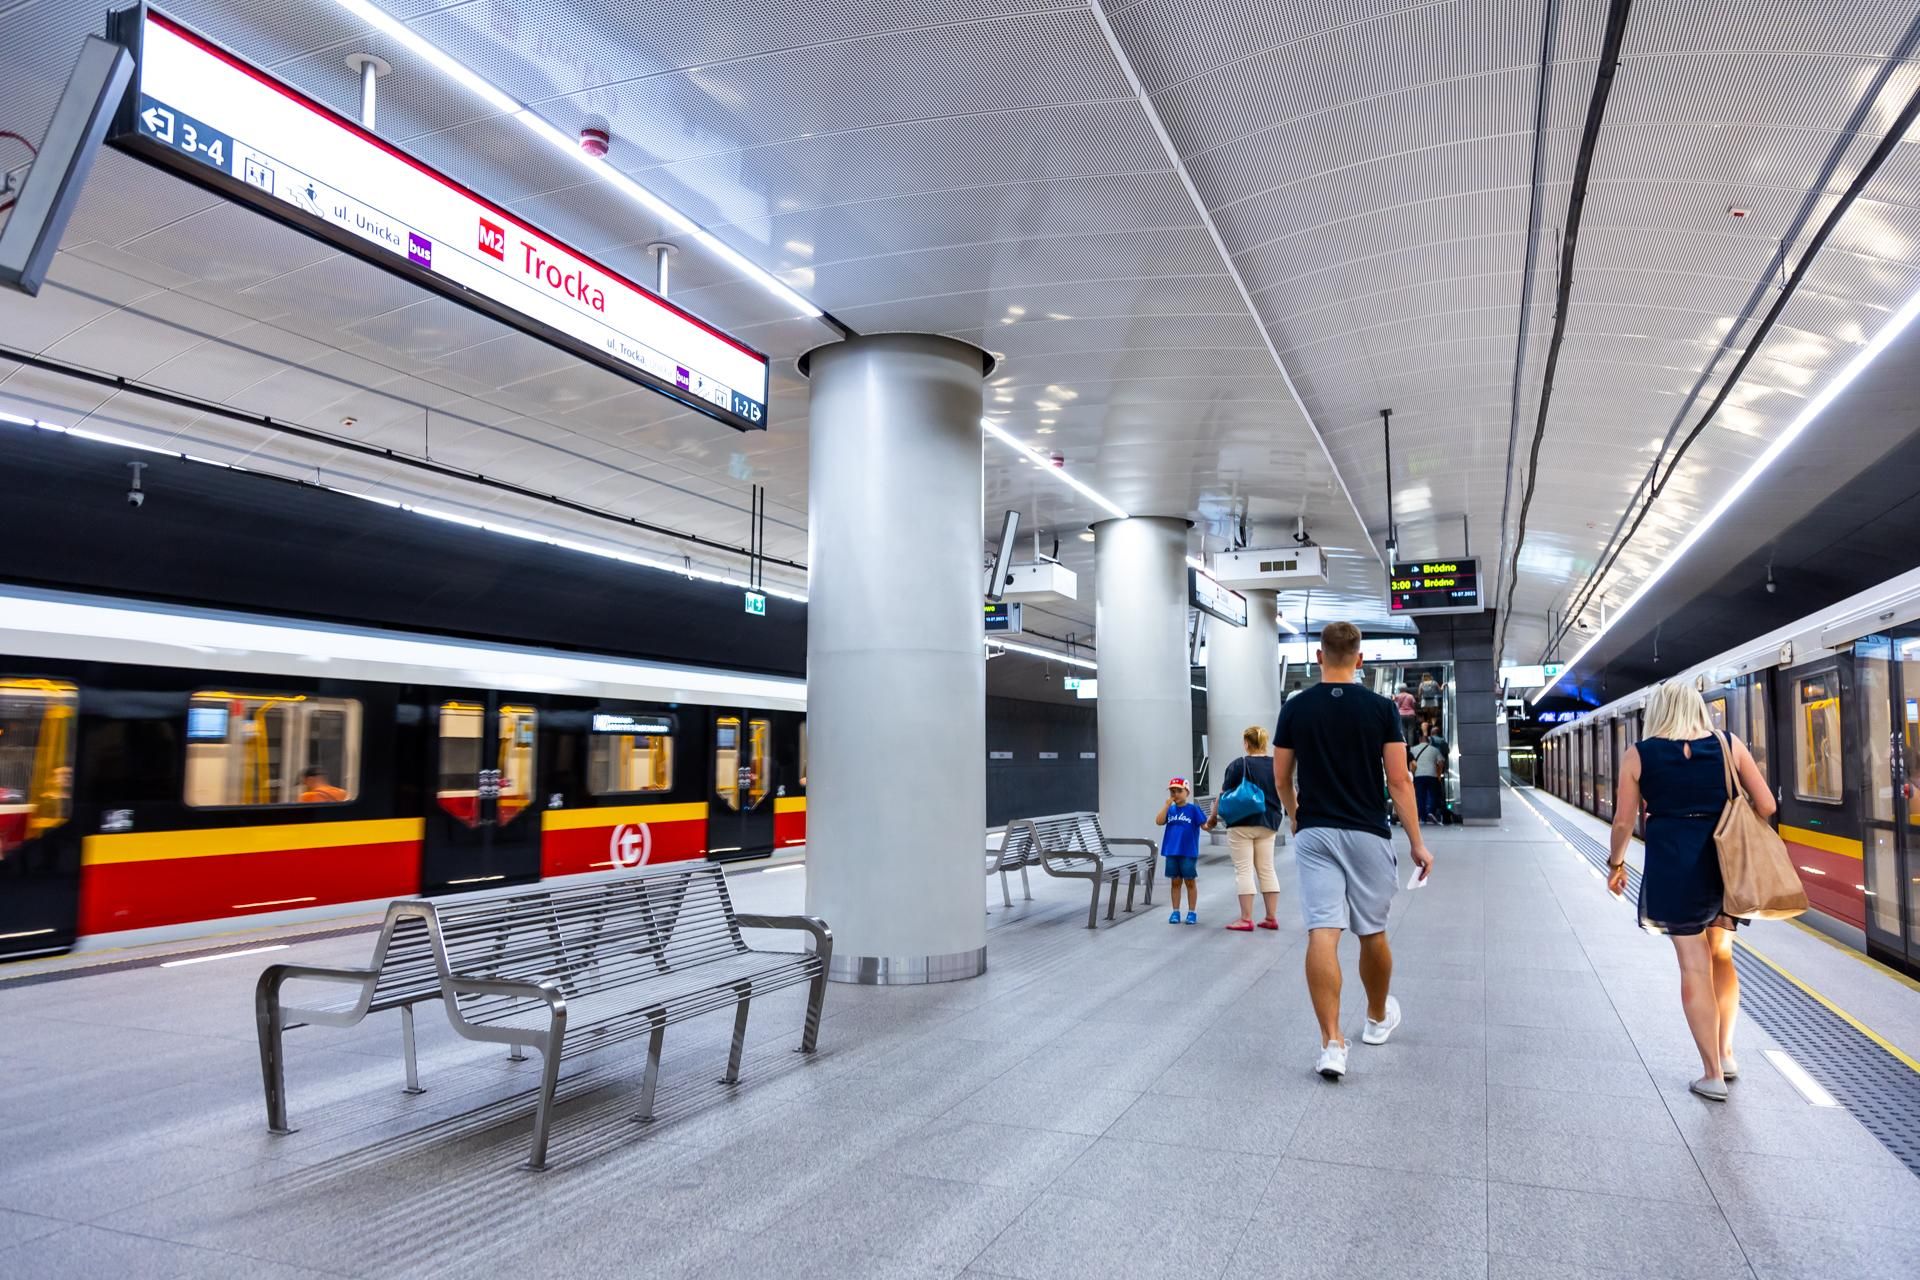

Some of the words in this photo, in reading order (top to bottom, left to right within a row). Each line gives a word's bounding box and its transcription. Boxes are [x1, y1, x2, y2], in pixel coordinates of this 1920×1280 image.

[182, 123, 225, 167] 3-4
[334, 206, 351, 222] ul.
[356, 213, 400, 246] Unicka
[409, 239, 431, 261] bus
[479, 224, 504, 254] M2
[520, 240, 605, 313] Trocka
[607, 338, 617, 351] ul.
[677, 370, 689, 386] bus
[734, 397, 749, 418] 1-2
[1423, 564, 1457, 574] Bródno
[1391, 580, 1411, 591] 3:00
[1424, 579, 1455, 588] Bródno
